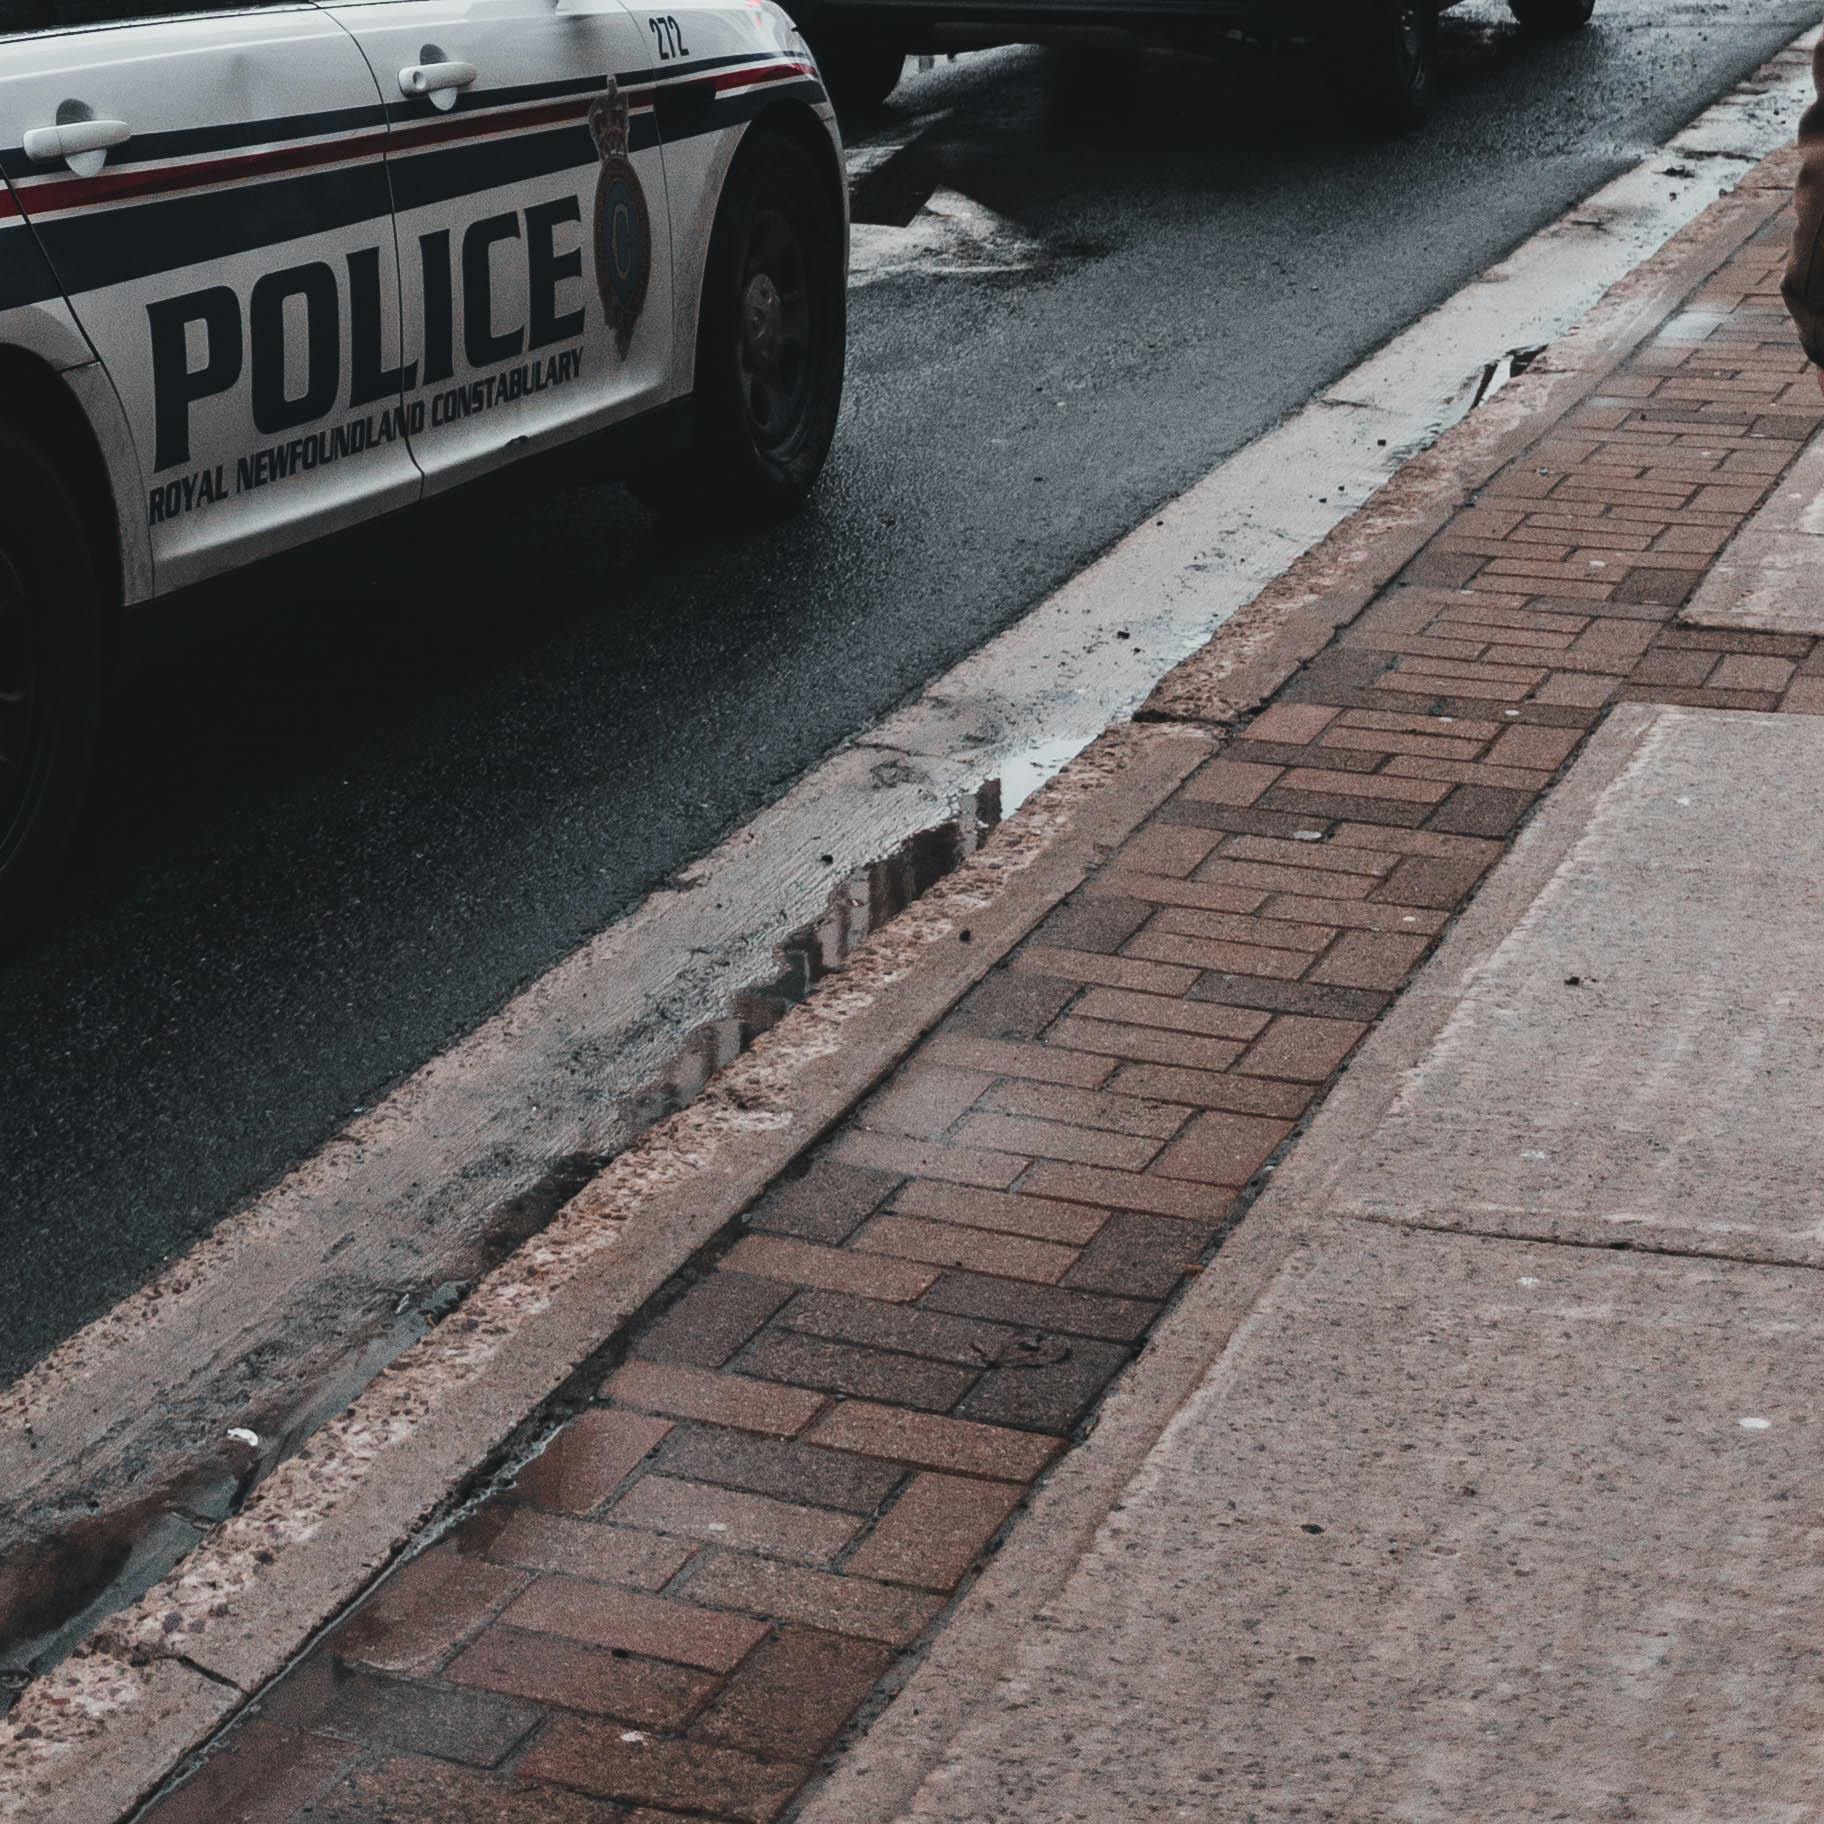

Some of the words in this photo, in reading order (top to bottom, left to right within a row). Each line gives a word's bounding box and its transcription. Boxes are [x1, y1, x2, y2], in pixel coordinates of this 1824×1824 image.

[649, 15, 689, 61] 272
[145, 194, 586, 473] POLICE
[149, 464, 229, 526] ROYAL
[236, 400, 425, 495] NEWFOUNDLAND
[431, 347, 584, 427] CONSTABULARY
